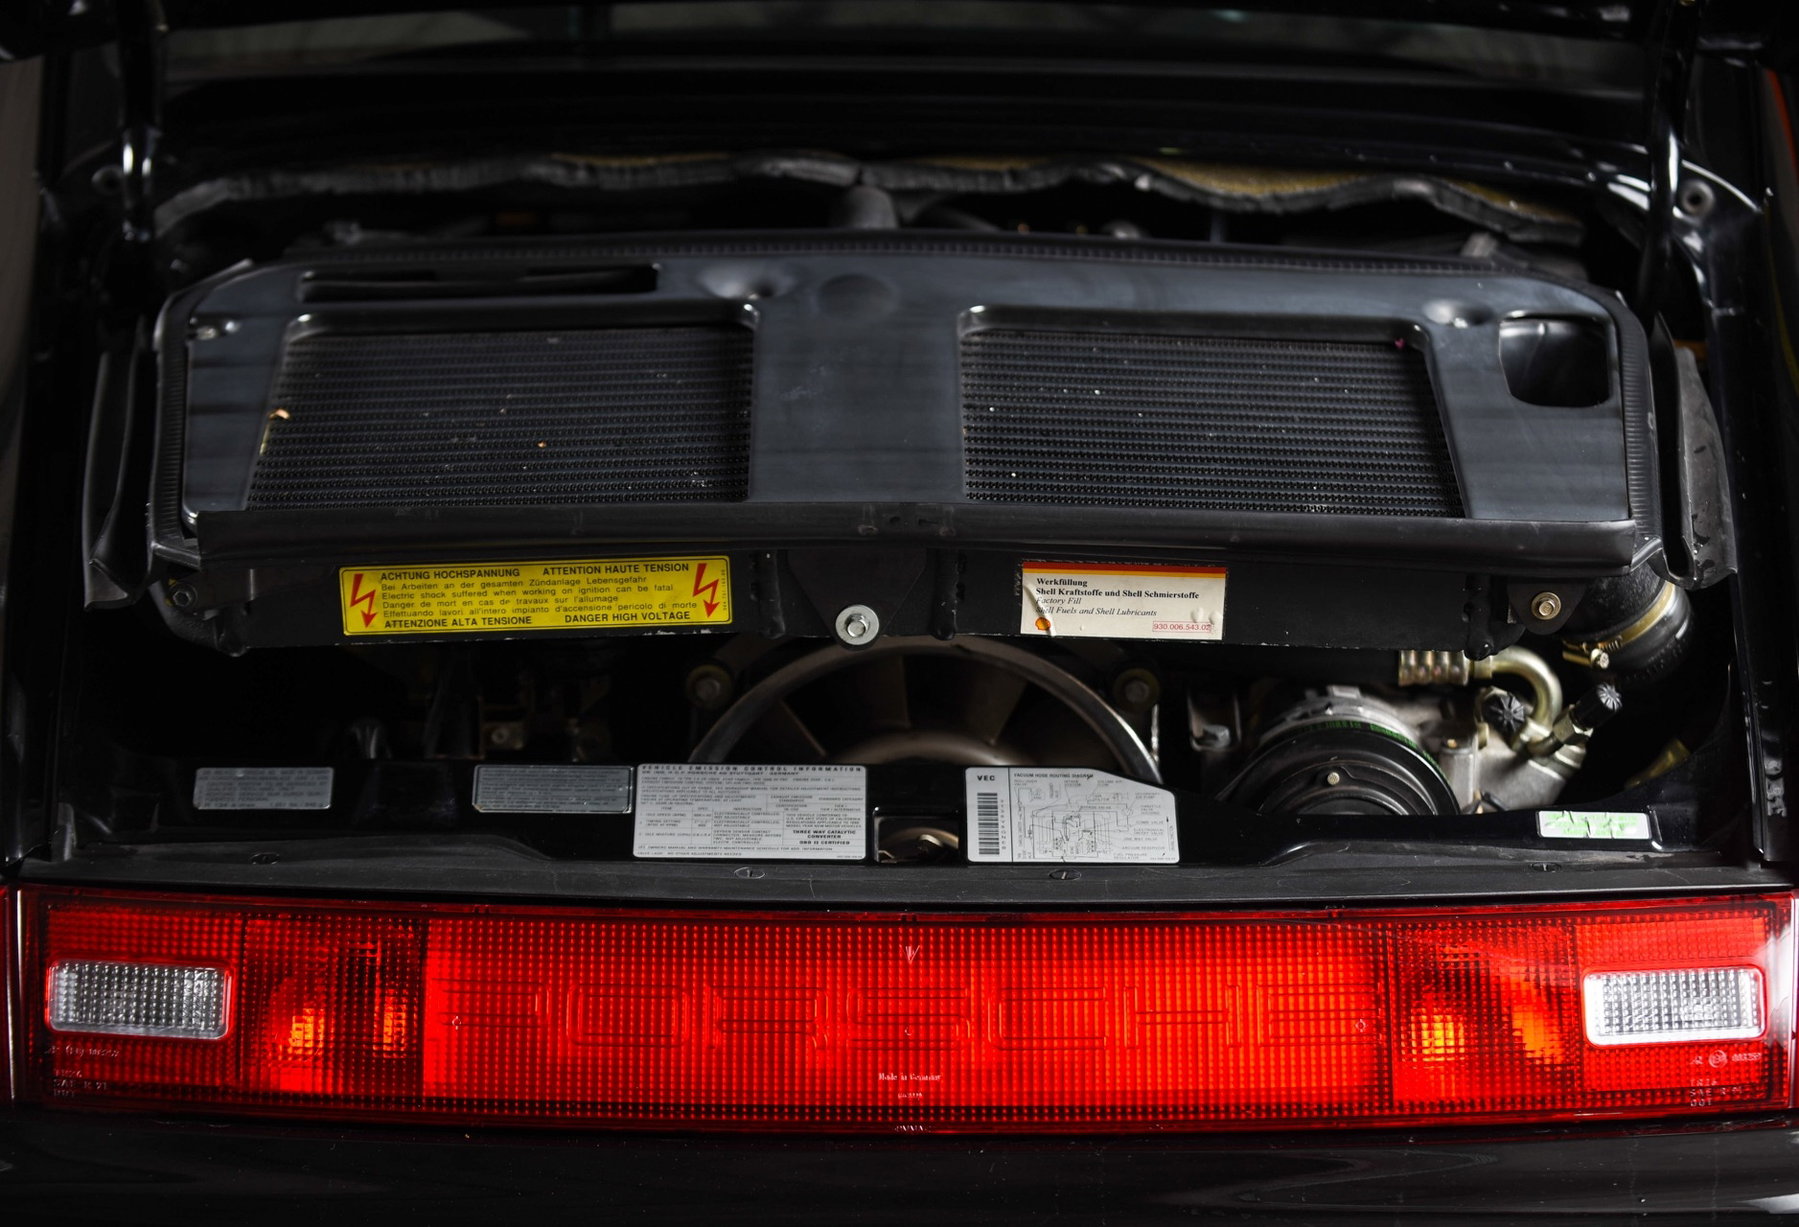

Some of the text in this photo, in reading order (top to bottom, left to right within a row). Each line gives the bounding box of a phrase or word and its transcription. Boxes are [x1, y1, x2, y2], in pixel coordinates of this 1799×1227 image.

[381, 569, 520, 580] ACHTUNG HOCHSPANNUNG
[543, 563, 689, 576] ATTENTION HAUTE TENSION
[401, 582, 438, 590] Arbeiten
[480, 580, 523, 590] gesamten
[529, 578, 581, 588] Zündanlage
[586, 576, 647, 586] Lebensgefahr
[1037, 578, 1088, 587] Werkfüllung
[382, 592, 415, 600] Electric
[420, 591, 446, 599] shock
[452, 590, 488, 598] suffered
[522, 587, 556, 596] working
[578, 586, 612, 595] ignition
[654, 584, 674, 592] fatal
[1122, 590, 1143, 598] Shell
[1144, 591, 1200, 599] Schmierstoffe
[383, 601, 415, 610] Danger
[420, 600, 431, 608] de
[574, 595, 618, 604] l'allumage
[1036, 597, 1066, 605] Factory
[384, 610, 433, 618] Effettuando
[439, 608, 463, 616] lavori
[469, 607, 506, 615] all'intero
[512, 606, 549, 615] impianto
[555, 604, 612, 613] d'accensione
[617, 603, 653, 612] pericolo
[1095, 608, 1115, 616] Shell
[1116, 608, 1157, 616] Lubricants
[384, 616, 532, 629] ATTENZIONE ALTA TENSIONE
[565, 611, 691, 623] DANGER HIGH VOLTAGE
[1153, 623, 1211, 631] 930.006.543.02
[428, 977, 1381, 1051] PORSCHE
